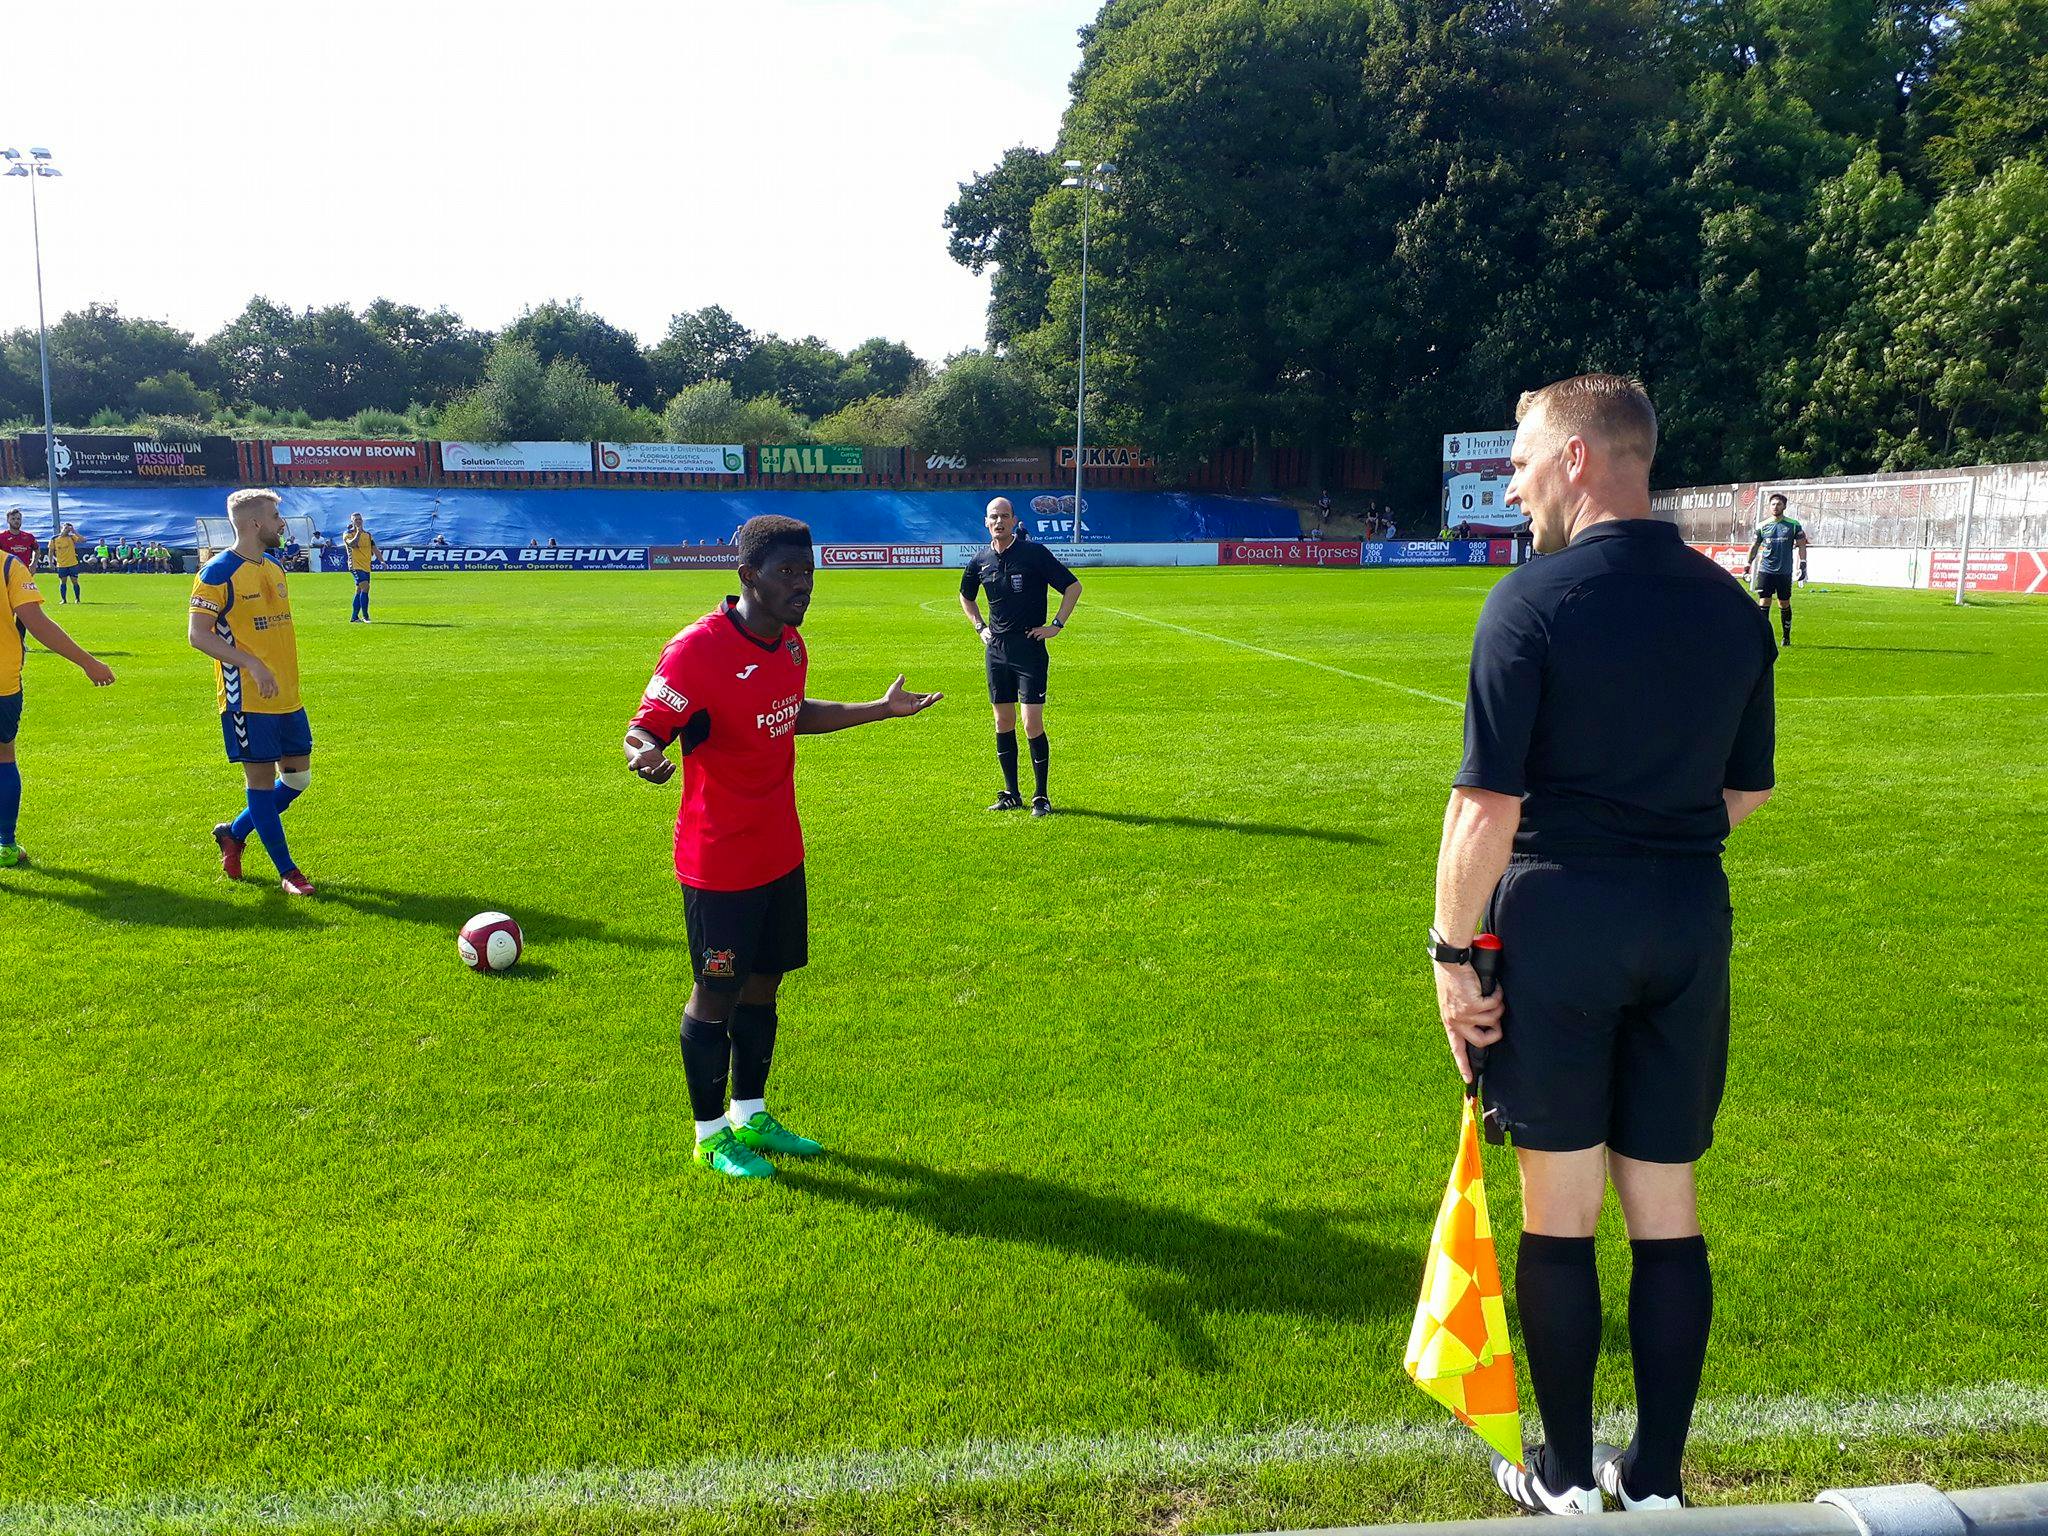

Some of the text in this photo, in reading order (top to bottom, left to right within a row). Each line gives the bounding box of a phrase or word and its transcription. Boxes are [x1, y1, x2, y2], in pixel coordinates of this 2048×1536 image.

[133, 442, 202, 453] INNOVATION
[1466, 436, 1515, 449] Thornbri
[74, 451, 130, 463] Thornbridge
[292, 446, 416, 457] WOSSKOW BROWN
[135, 453, 185, 465] PASSION
[294, 457, 329, 465] Solicitors
[461, 458, 525, 466] SolutionTelecom
[760, 447, 829, 473] HALL
[137, 464, 207, 476] KNOWLEDGE
[1680, 493, 1716, 510] METALS
[1716, 491, 1733, 507] LTD
[1036, 520, 1090, 532] FIFA
[892, 547, 941, 555] ADHESIVES
[1407, 541, 1450, 551] ORIGIN
[1468, 541, 1487, 550] 0800
[518, 549, 645, 561] BEEHIVE
[836, 551, 885, 561] EVO-STIK
[1235, 545, 1359, 559] Coach & Horses
[673, 553, 739, 563] www.bootsfor
[892, 556, 941, 564] & SEALANTS
[1468, 555, 1486, 563] 2333
[772, 694, 798, 710] CLASSIC
[757, 701, 802, 729] FOOTBA
